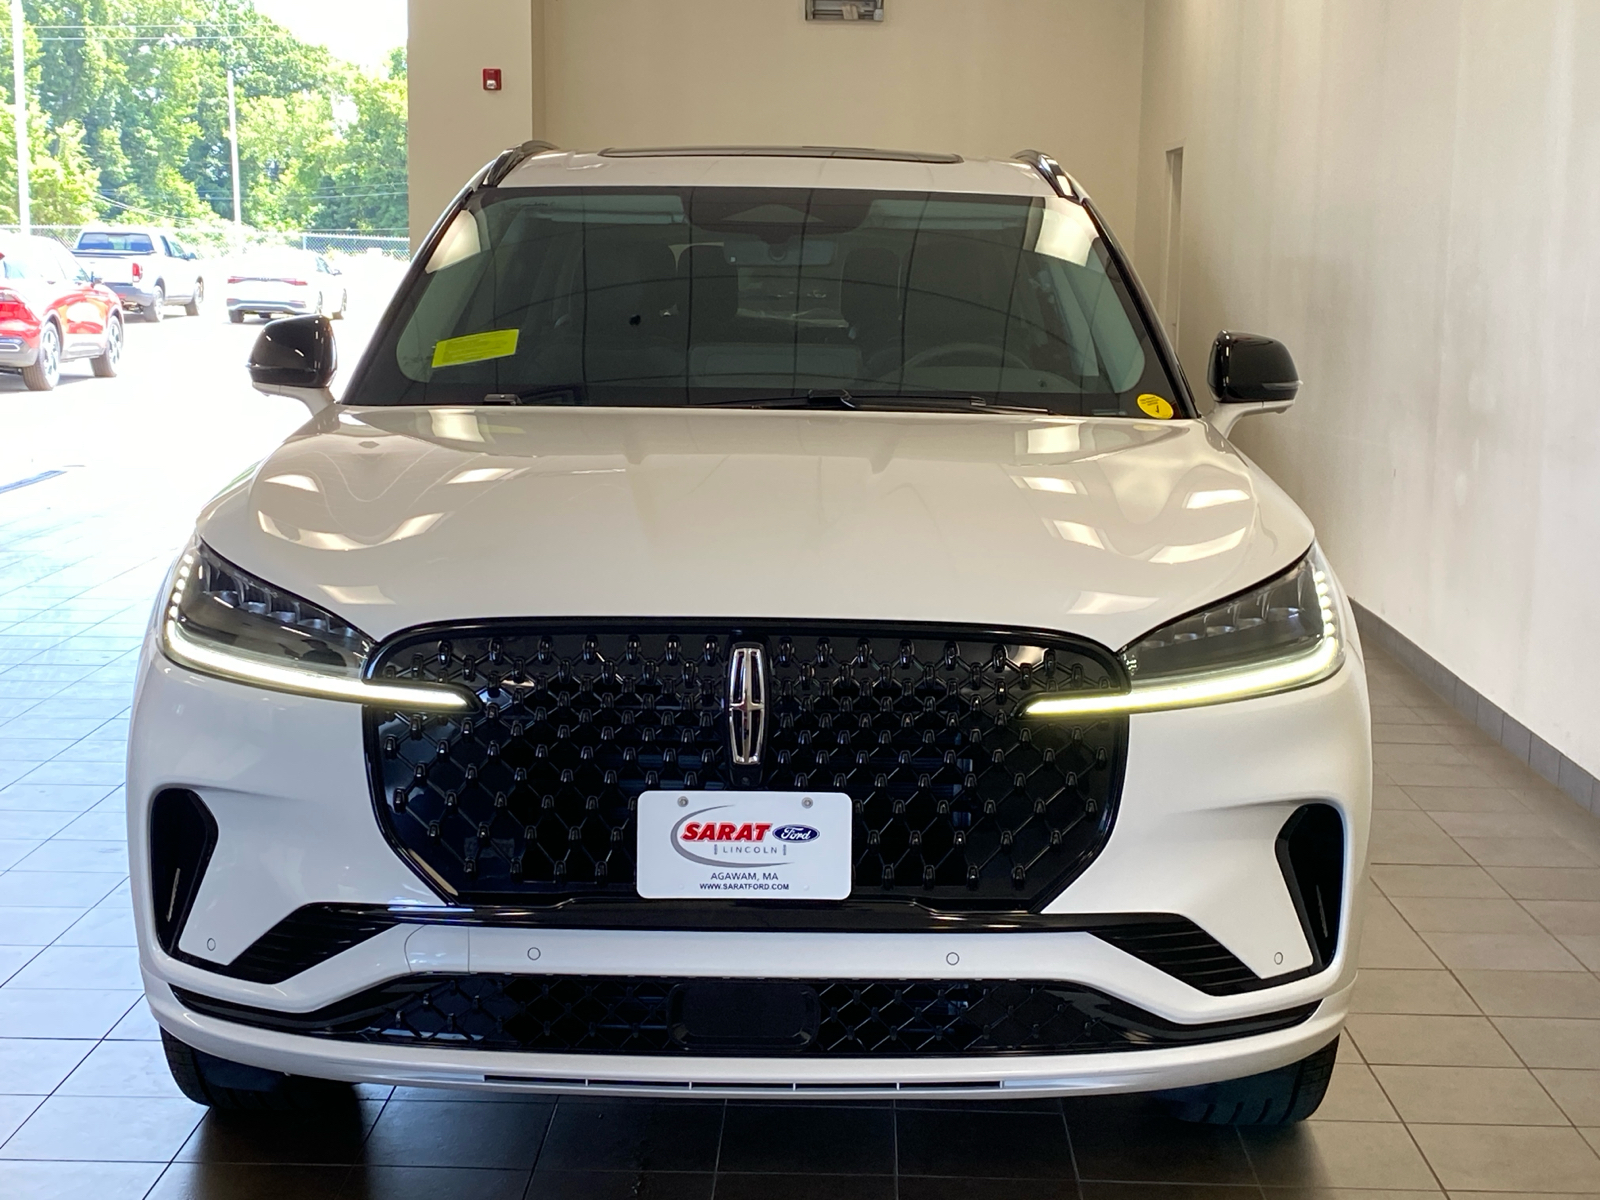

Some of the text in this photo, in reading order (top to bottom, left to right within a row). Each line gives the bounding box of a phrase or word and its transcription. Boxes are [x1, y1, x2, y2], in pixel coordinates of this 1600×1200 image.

[682, 822, 812, 842] SARAT Ford
[723, 846, 778, 854] LINCOLN
[710, 872, 779, 881] AGAWAM, MA
[699, 883, 790, 891] WWW.SARATFORD.COM
